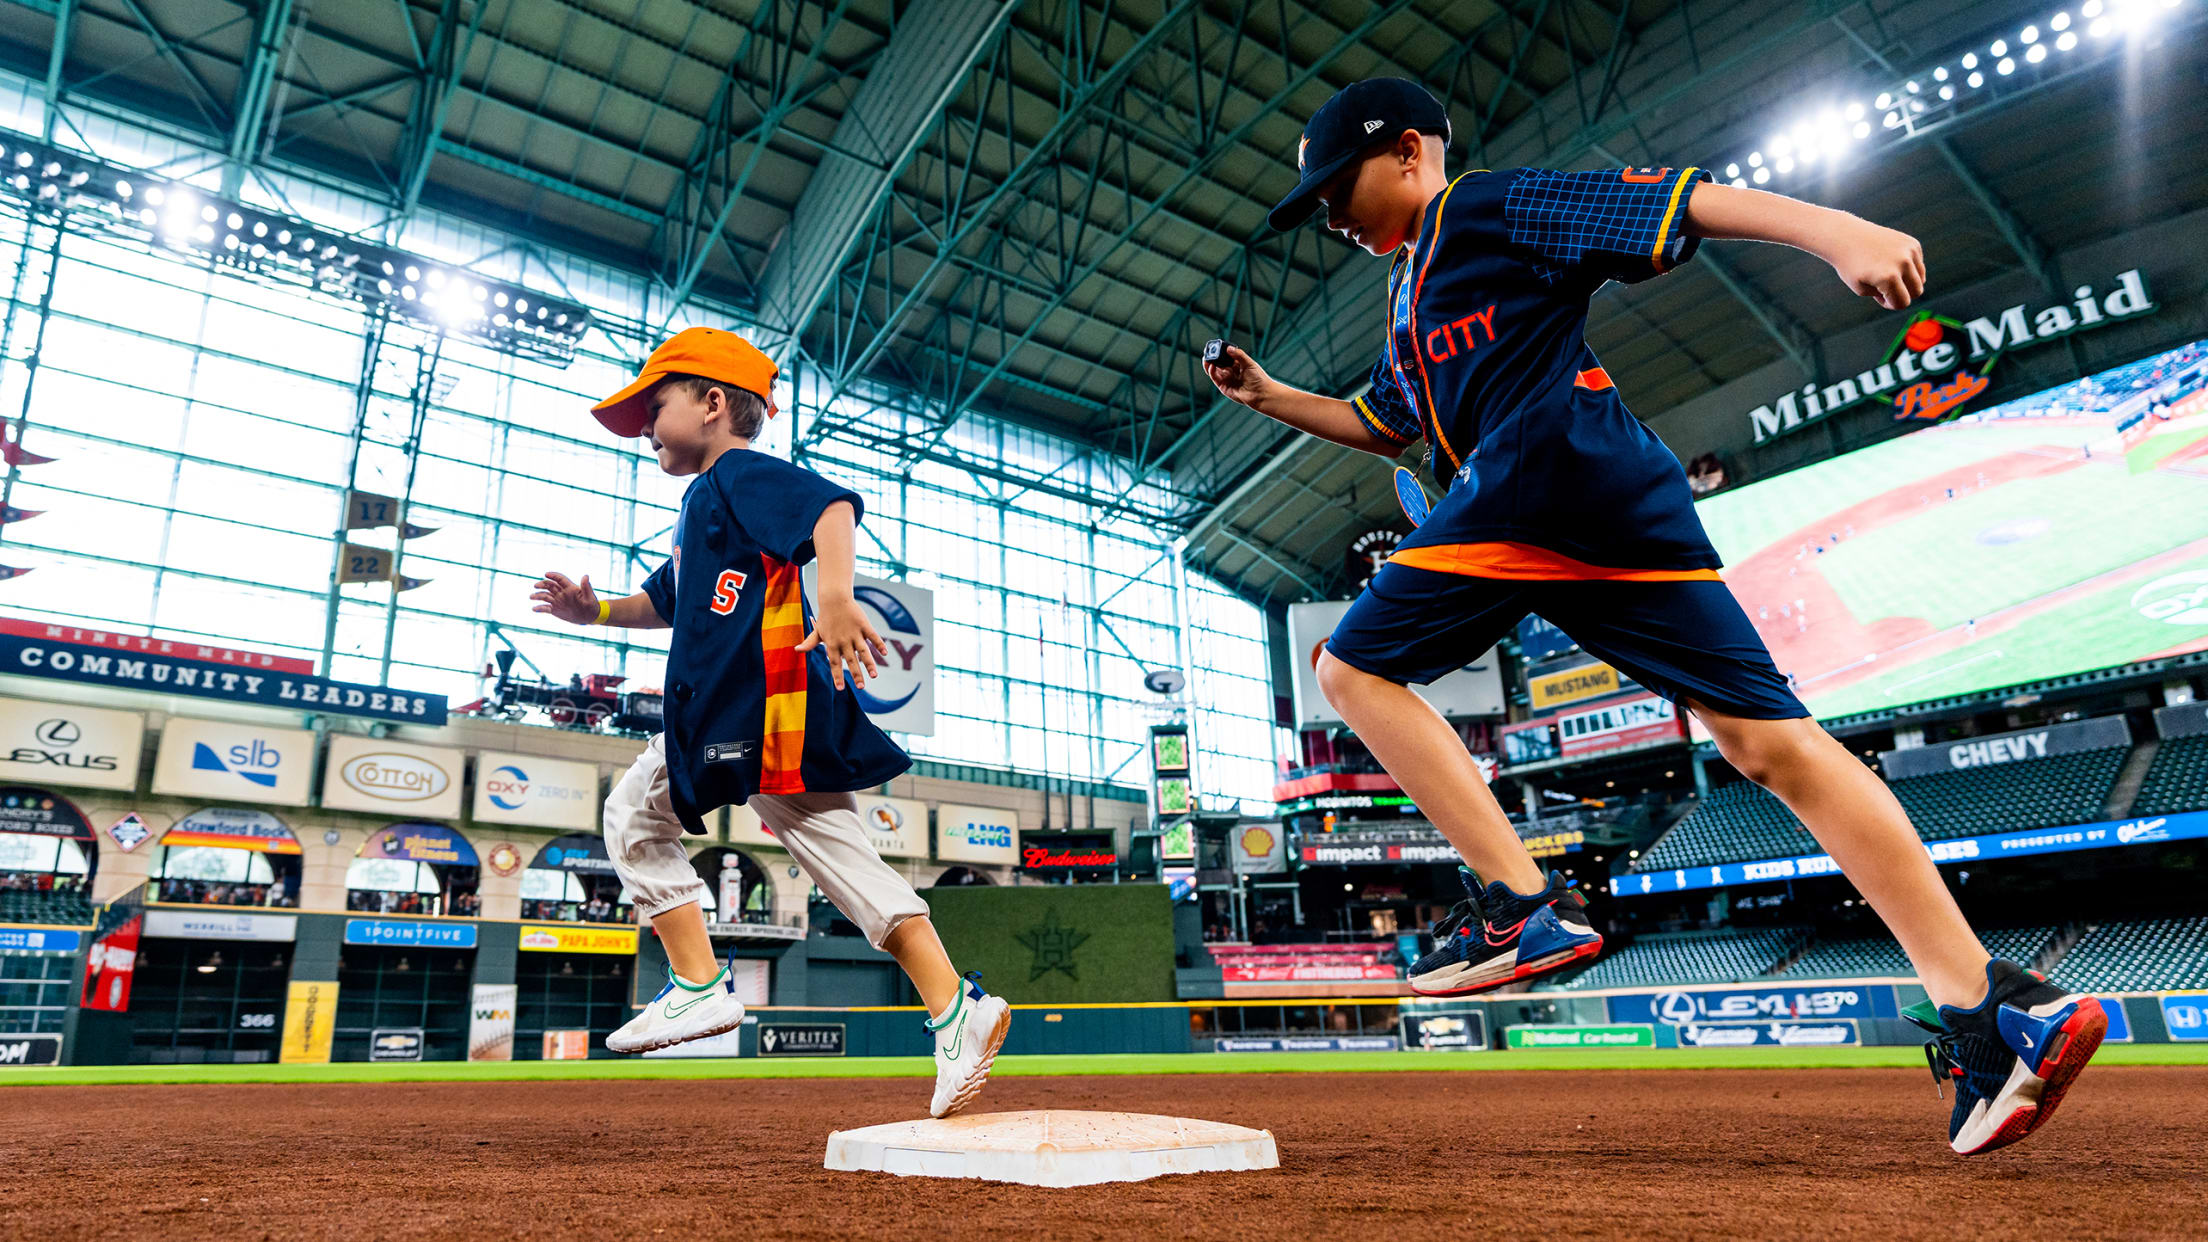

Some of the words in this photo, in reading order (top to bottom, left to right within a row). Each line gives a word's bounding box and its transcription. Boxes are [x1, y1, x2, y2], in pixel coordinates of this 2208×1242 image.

[1427, 305, 1496, 364] CITY
[1748, 341, 1957, 444] Minute
[1964, 269, 2153, 359] Maid
[1895, 372, 1989, 419] Park
[360, 502, 387, 521] 17
[1352, 530, 1403, 552] HOUSTO
[351, 557, 379, 574] 22
[710, 568, 748, 616] S
[47, 626, 173, 653] MINUTE
[198, 647, 275, 666] MAID
[20, 647, 265, 694] COMMUNITY
[280, 680, 427, 716] LEADERS
[1544, 671, 1610, 697] MUSTANG
[229, 739, 280, 768] slb
[1949, 731, 2049, 769] CHEVY
[356, 762, 433, 792] COTTON
[487, 781, 529, 795] OXY
[183, 820, 248, 835] Crawford
[968, 823, 1011, 848] LNG
[1023, 848, 1117, 868] Budweiser
[1316, 844, 1382, 863] impact
[1401, 843, 1461, 863] impac
[1743, 860, 1795, 880] KIDS
[365, 927, 461, 941] 1POINTFIVE
[561, 934, 589, 948] PAPA
[240, 1014, 275, 1028] 366
[476, 1009, 511, 1021] WM
[779, 1031, 839, 1044] VERITEX
